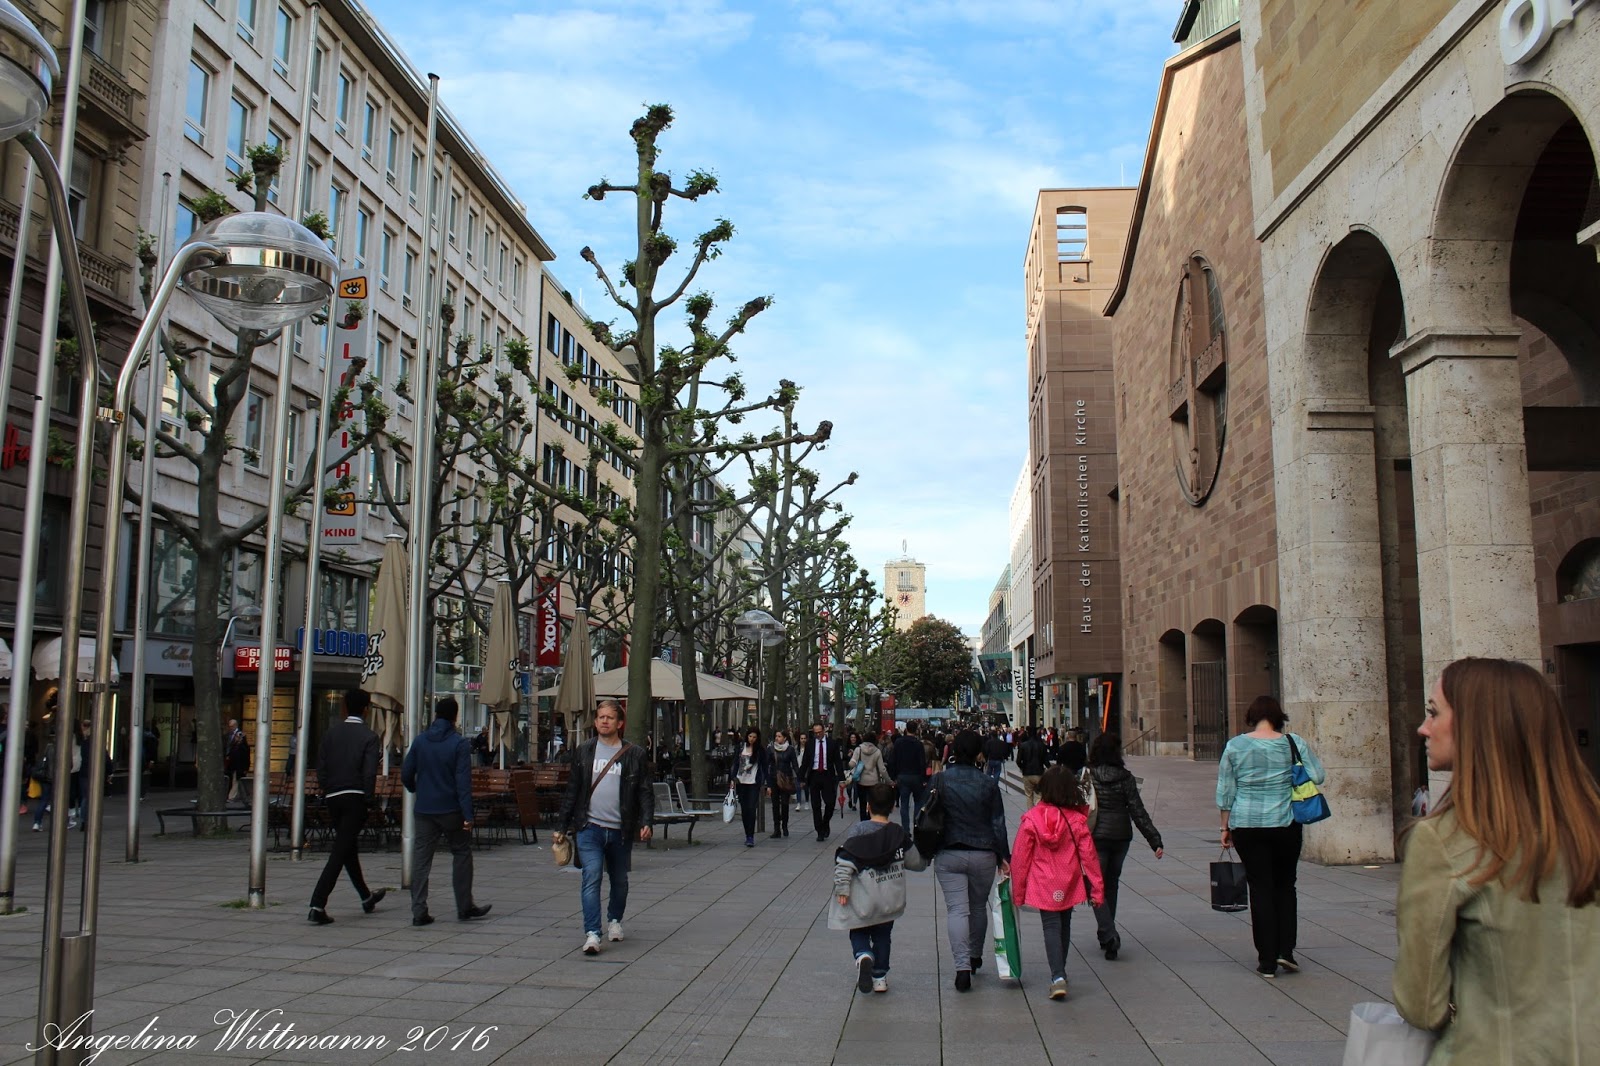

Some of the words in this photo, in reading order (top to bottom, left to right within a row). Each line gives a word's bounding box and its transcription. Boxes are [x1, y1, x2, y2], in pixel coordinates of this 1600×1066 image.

[1075, 398, 1087, 445] Kirche
[1076, 455, 1090, 552] Katholischen
[324, 527, 356, 537] KINO
[1079, 562, 1091, 587] der
[1080, 596, 1092, 634] Haus
[248, 657, 290, 670] Page
[249, 648, 290, 657] GLRIA
